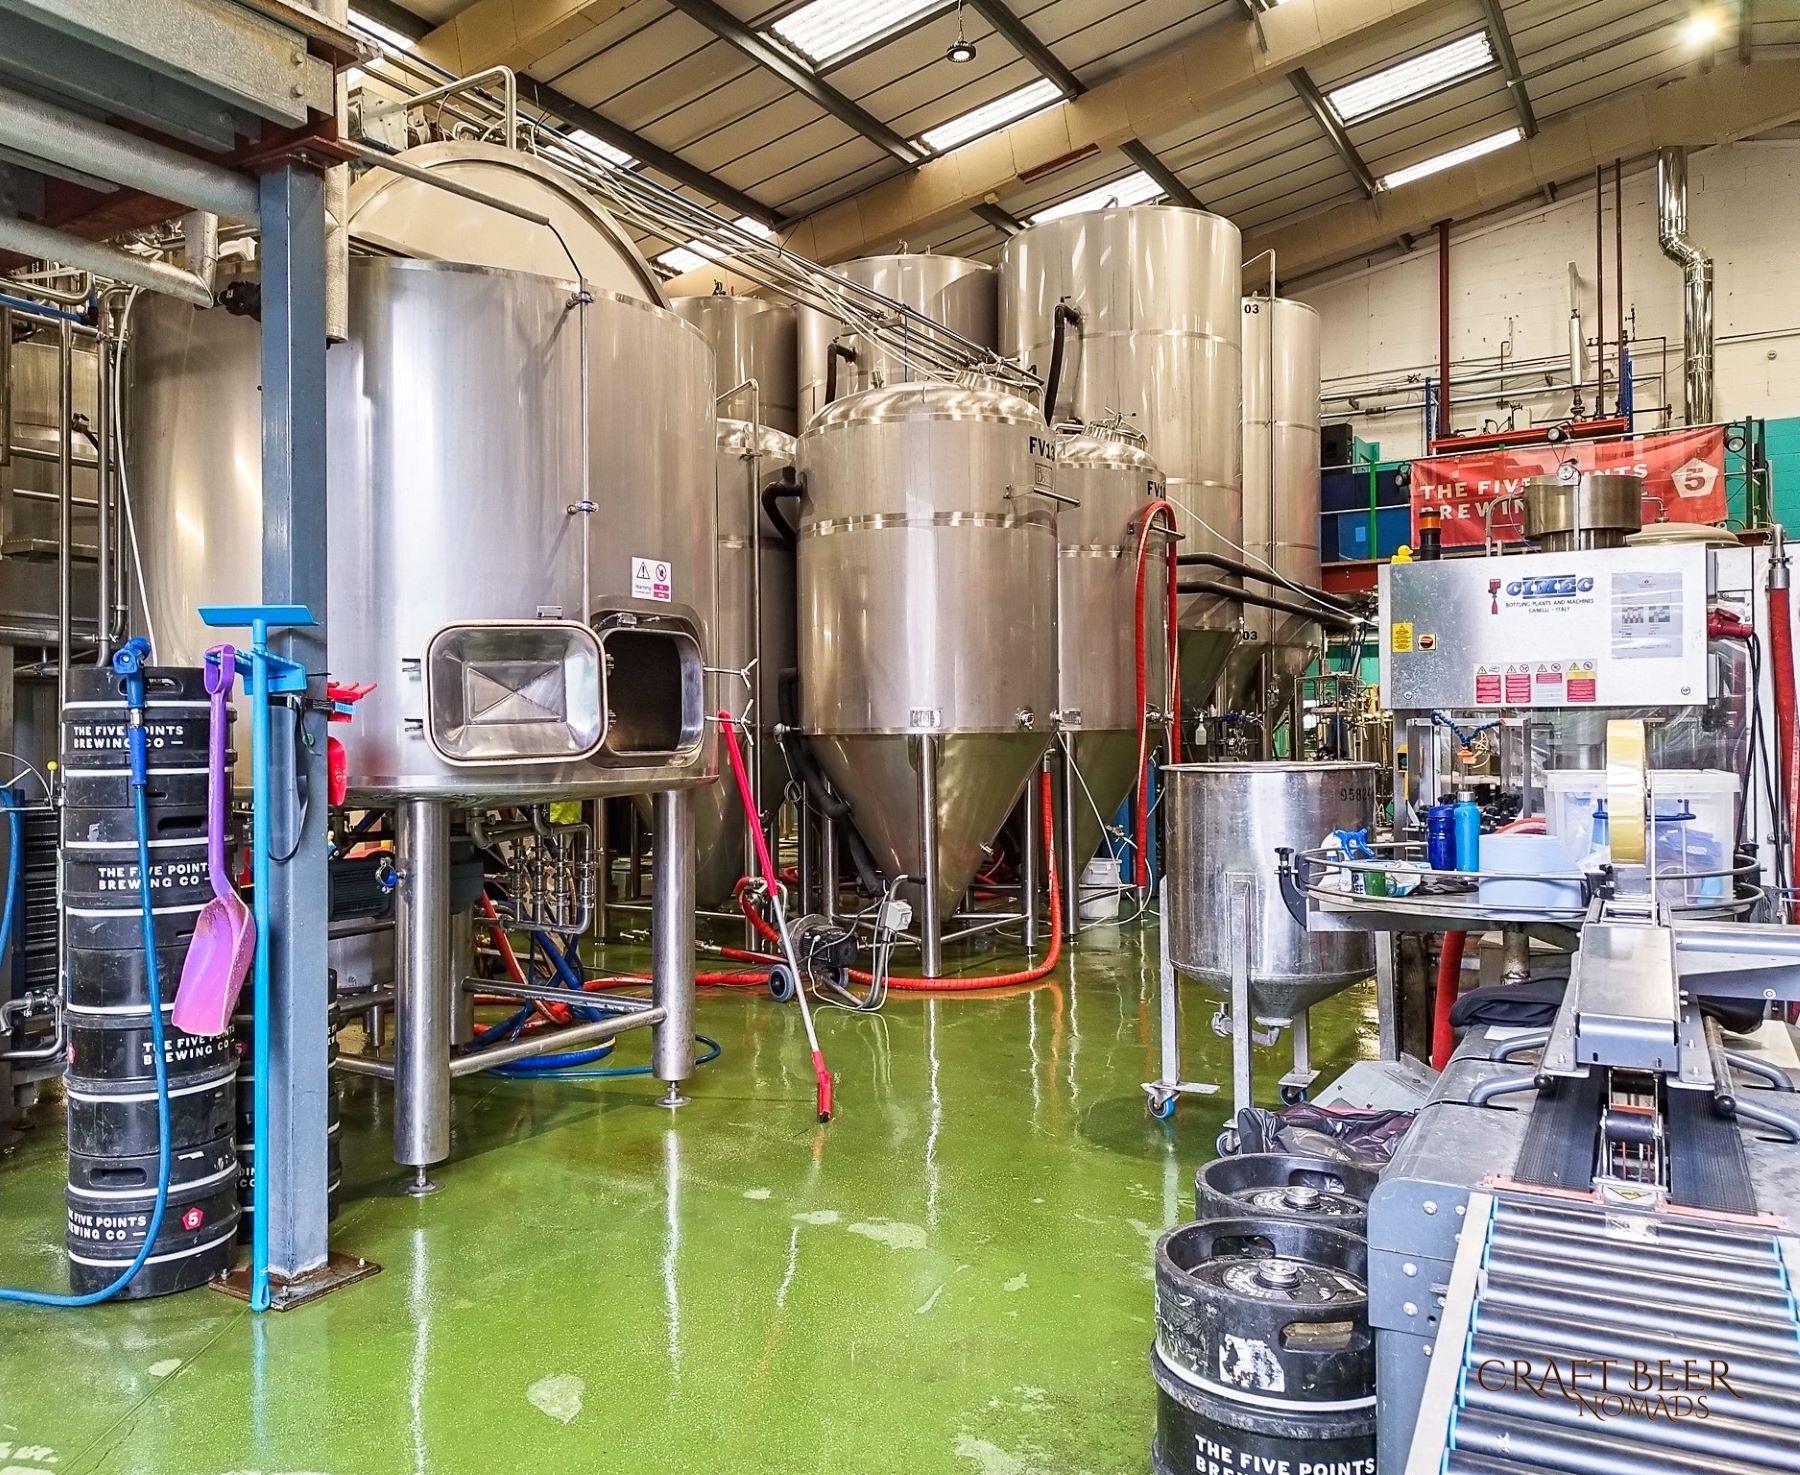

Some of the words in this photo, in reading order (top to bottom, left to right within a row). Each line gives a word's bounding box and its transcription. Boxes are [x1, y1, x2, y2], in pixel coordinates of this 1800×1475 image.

[1244, 304, 1259, 314] 03
[1029, 435, 1055, 462] FV13
[1684, 467, 1706, 491] 5
[1420, 481, 1468, 500] THE
[1506, 575, 1594, 598] CIMEC
[1242, 631, 1258, 640] 03
[73, 726, 92, 736] THE
[95, 726, 125, 736] FIVE
[98, 867, 125, 878] THE
[168, 862, 210, 875] POINT
[99, 878, 172, 890] BREWNG
[180, 875, 199, 886] CO
[143, 1045, 213, 1066] BEWING
[217, 1039, 229, 1051] CO
[74, 1212, 93, 1227] FIVE
[96, 1216, 147, 1228] POINTS
[187, 1211, 199, 1226] 5
[105, 1229, 127, 1241] CO
[1194, 1433, 1233, 1465] THE
[1240, 1452, 1290, 1475] FIVE
[1299, 1457, 1376, 1475] POINTS
